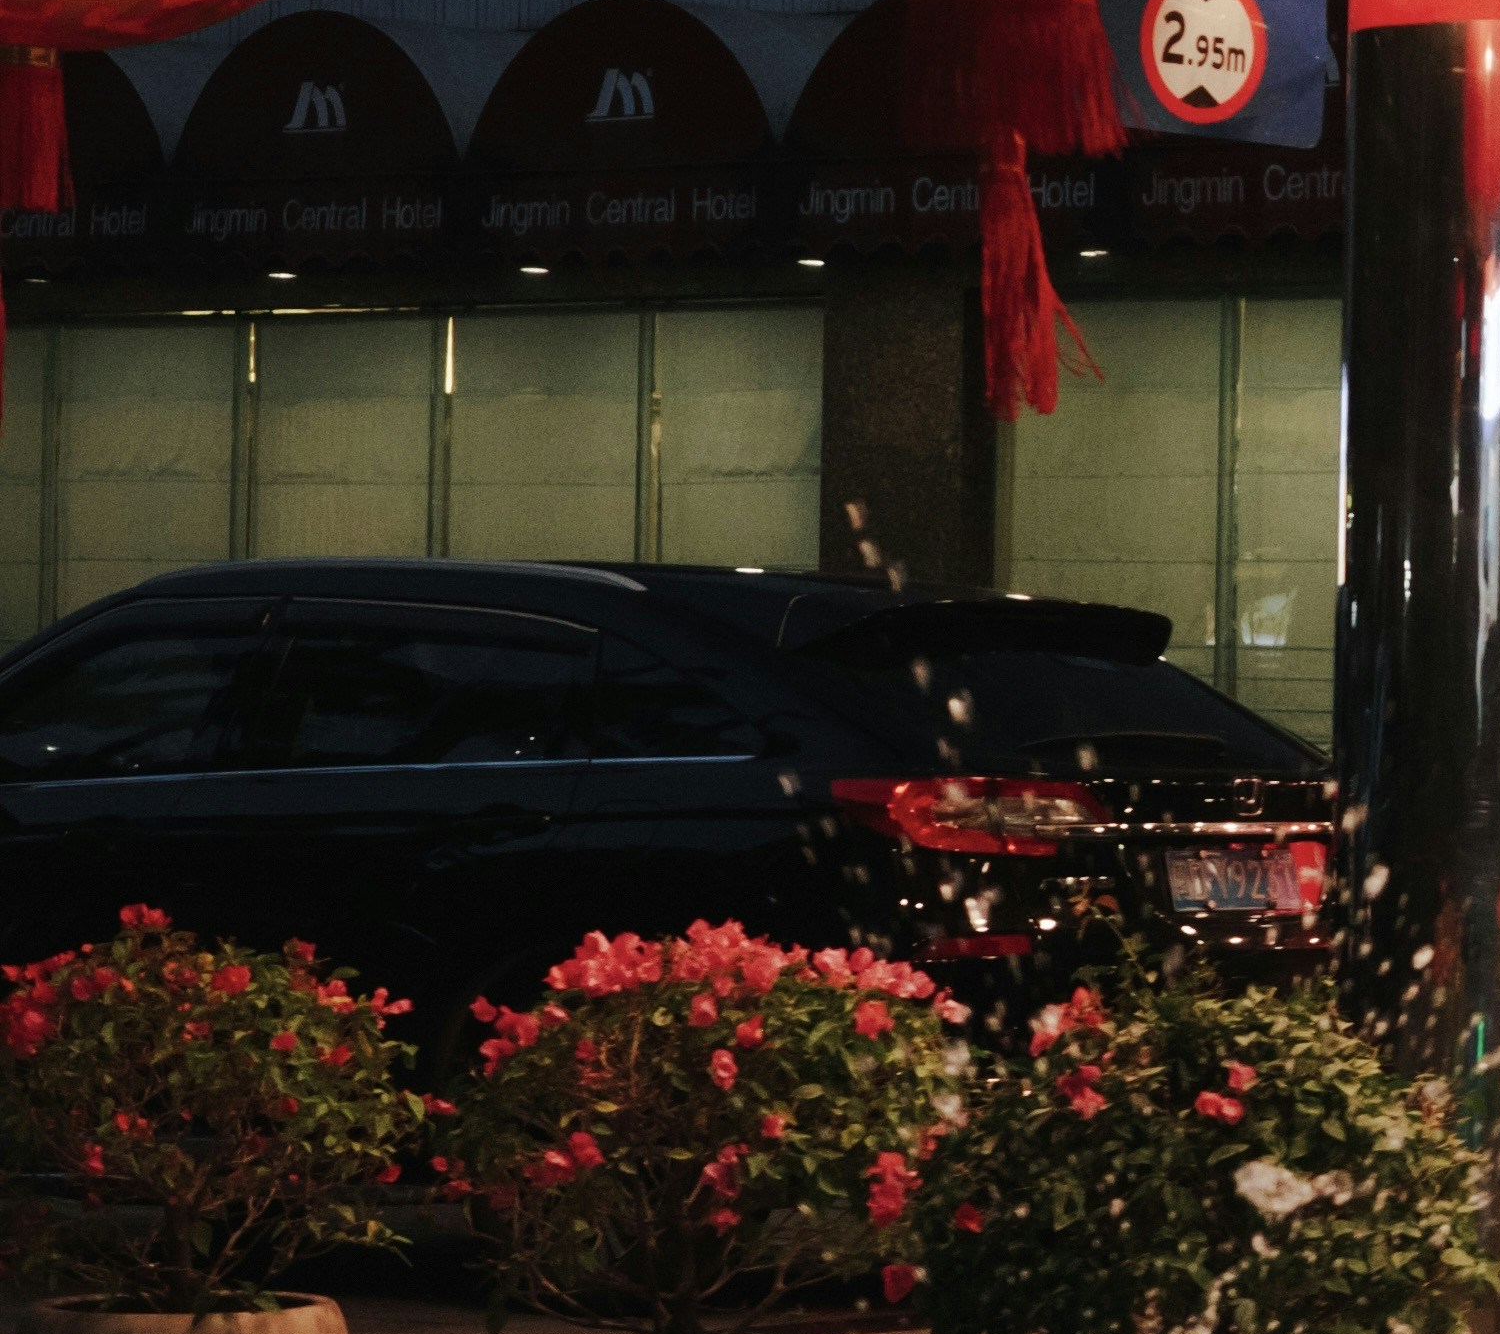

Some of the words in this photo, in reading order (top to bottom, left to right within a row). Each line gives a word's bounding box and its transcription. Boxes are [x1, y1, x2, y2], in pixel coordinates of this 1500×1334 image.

[1161, 11, 1246, 74] 2.95m
[481, 195, 570, 236] Jingmin
[585, 188, 676, 225] Central
[692, 186, 757, 222] Hotel
[799, 180, 895, 225] Jingmin
[1026, 172, 1095, 209] Hotel
[1142, 169, 1245, 213] Jingmin
[89, 203, 146, 236] Hotel
[185, 202, 268, 242] Jingmin
[282, 196, 367, 233] Central
[382, 196, 443, 231] Hotel
